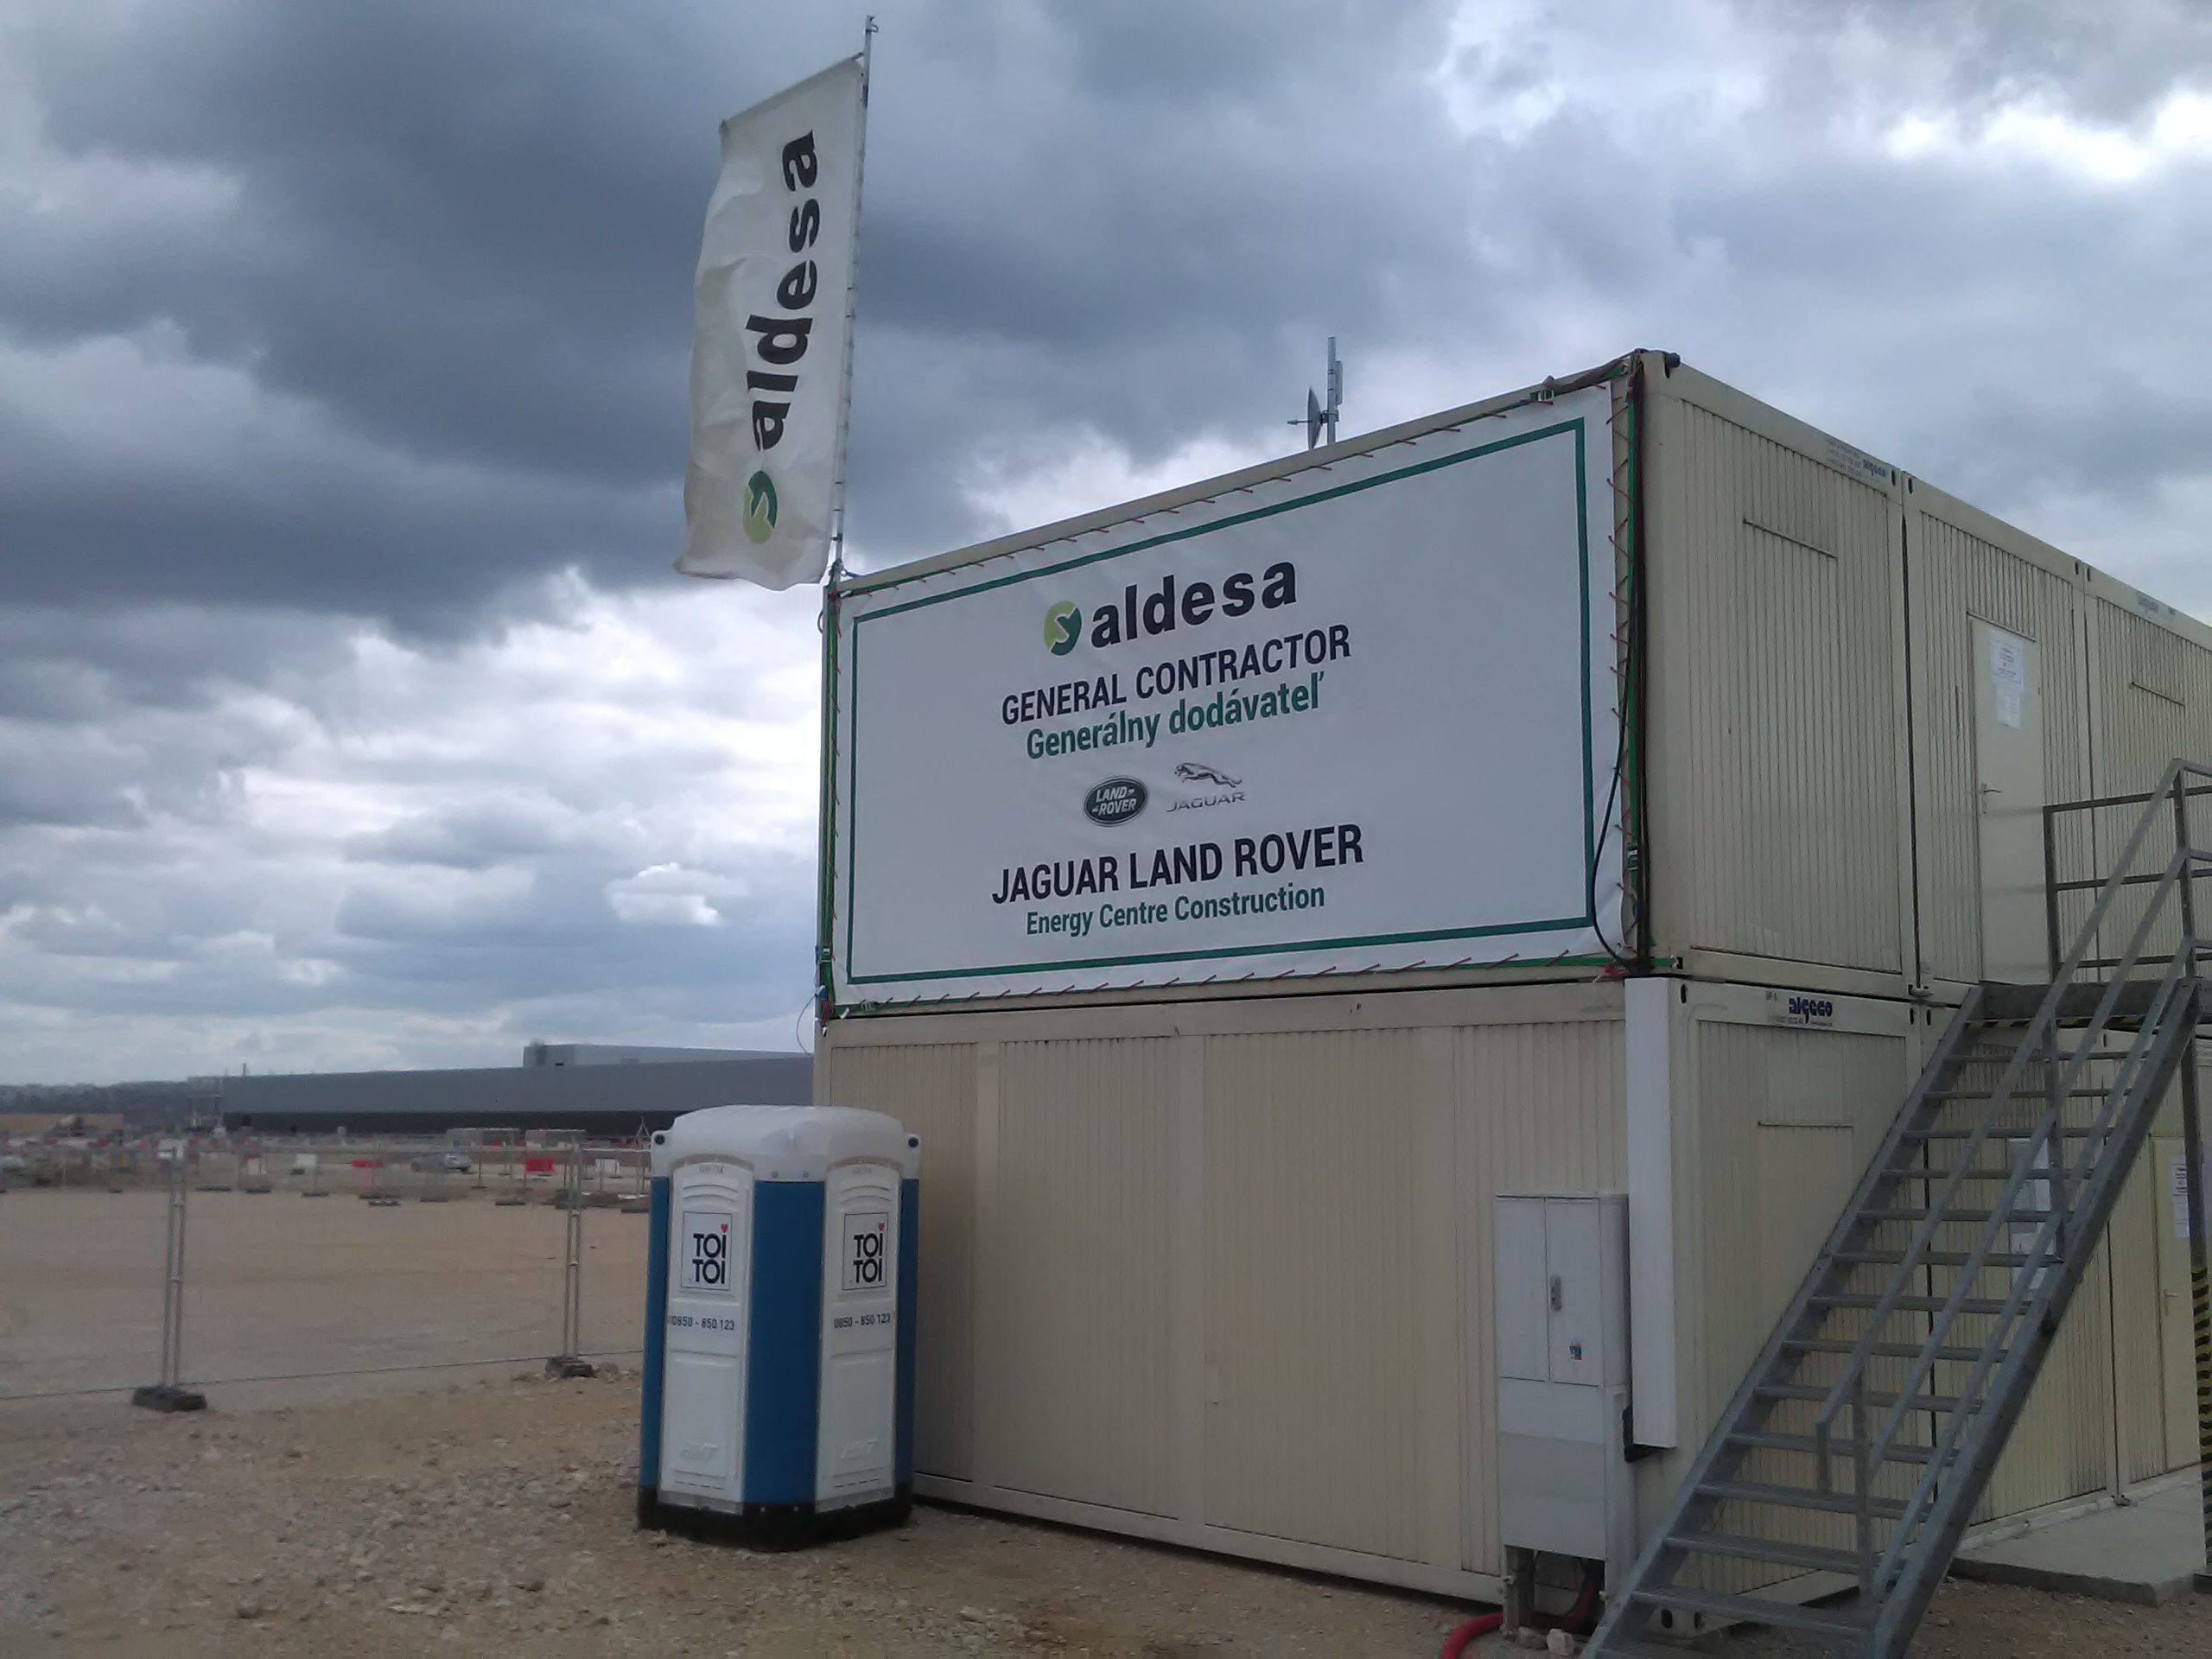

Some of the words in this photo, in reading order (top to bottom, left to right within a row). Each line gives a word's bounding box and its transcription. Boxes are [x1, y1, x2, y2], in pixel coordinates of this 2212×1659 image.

[744, 129, 821, 452] aldesa
[1090, 562, 1297, 649] aldesa
[1002, 673, 1127, 726] GENERAL
[1136, 624, 1351, 700] CONTRACTOR
[1027, 709, 1161, 760] Generálny
[1170, 671, 1325, 734] dodávateľ
[1096, 786, 1128, 803] LAND
[1098, 798, 1137, 817] ROVER
[1166, 791, 1246, 812] JAGUAR
[992, 855, 1119, 905] JAGUAR
[1128, 842, 1224, 889] LAND
[1235, 823, 1364, 878] ROVER
[1027, 907, 1093, 938] Energy
[1099, 899, 1168, 929] Centre
[1174, 882, 1325, 921] Construction
[692, 1259, 725, 1285] TOI
[853, 1258, 882, 1283] TOI
[720, 1319, 734, 1331] 123
[877, 1313, 891, 1324] 123
